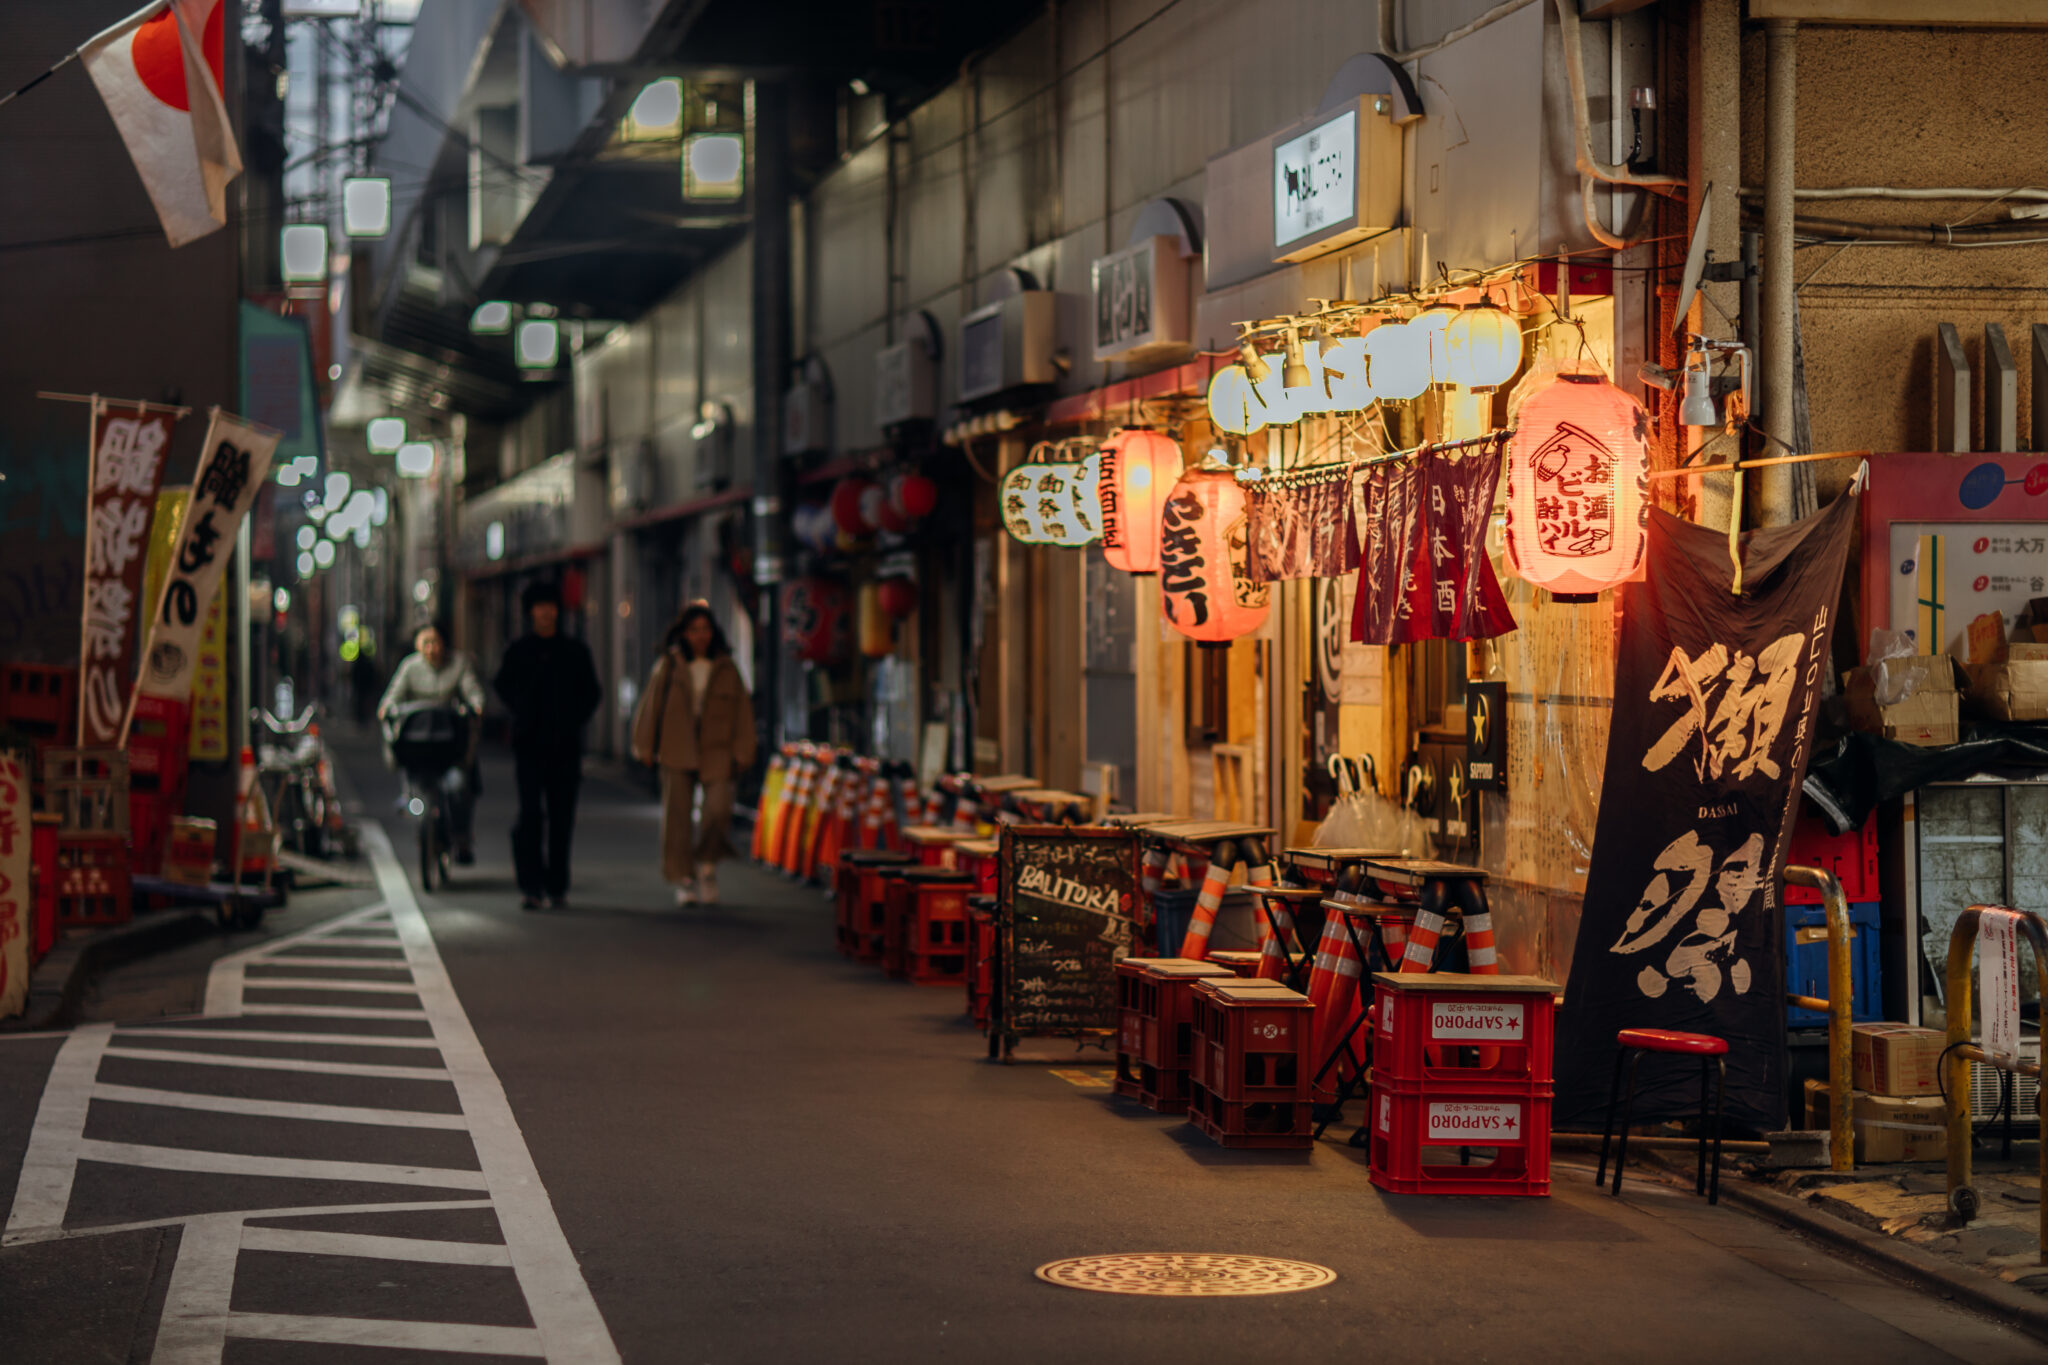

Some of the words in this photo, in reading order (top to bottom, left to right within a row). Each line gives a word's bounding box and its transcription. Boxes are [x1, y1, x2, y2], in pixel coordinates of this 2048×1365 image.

[1584, 454, 1609, 521] お酒
[1557, 471, 1590, 538] ビール
[1470, 762, 1493, 780] SAPPORO
[1435, 1015, 1504, 1029] SAPPORO
[1431, 1115, 1500, 1129] SAPPORO
